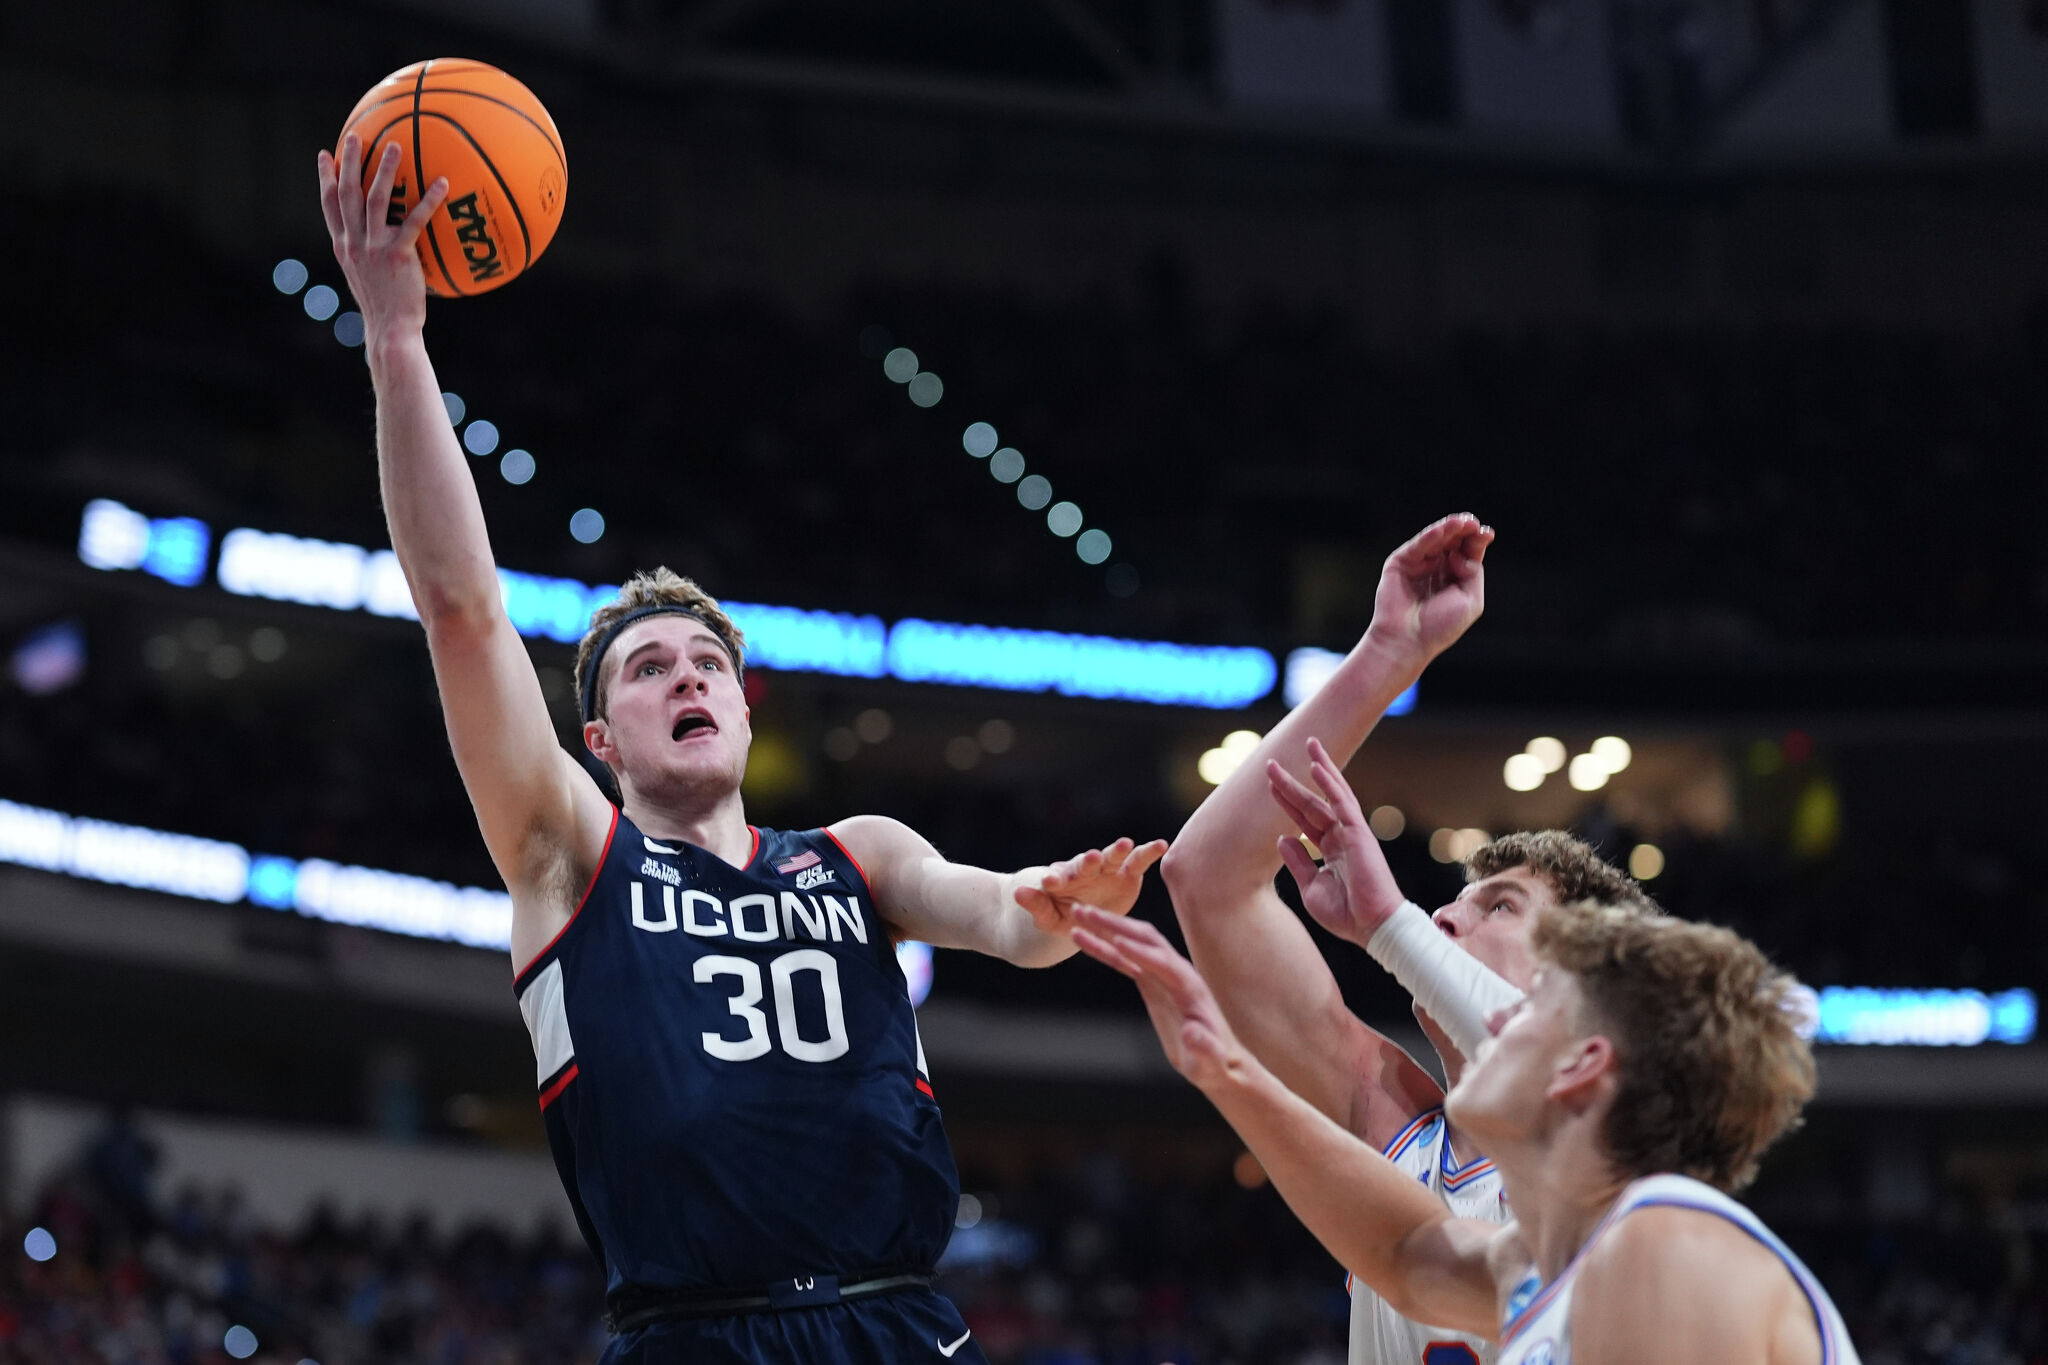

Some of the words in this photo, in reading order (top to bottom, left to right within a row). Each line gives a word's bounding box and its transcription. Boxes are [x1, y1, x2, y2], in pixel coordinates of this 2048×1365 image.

[446, 189, 505, 283] NCAA
[641, 863, 682, 887] CHANGE
[645, 856, 659, 868] BE
[661, 863, 680, 876] THE
[796, 864, 823, 882] BIG
[796, 870, 835, 890] EAST
[630, 881, 868, 944] UCONN
[692, 948, 850, 1063] 30
